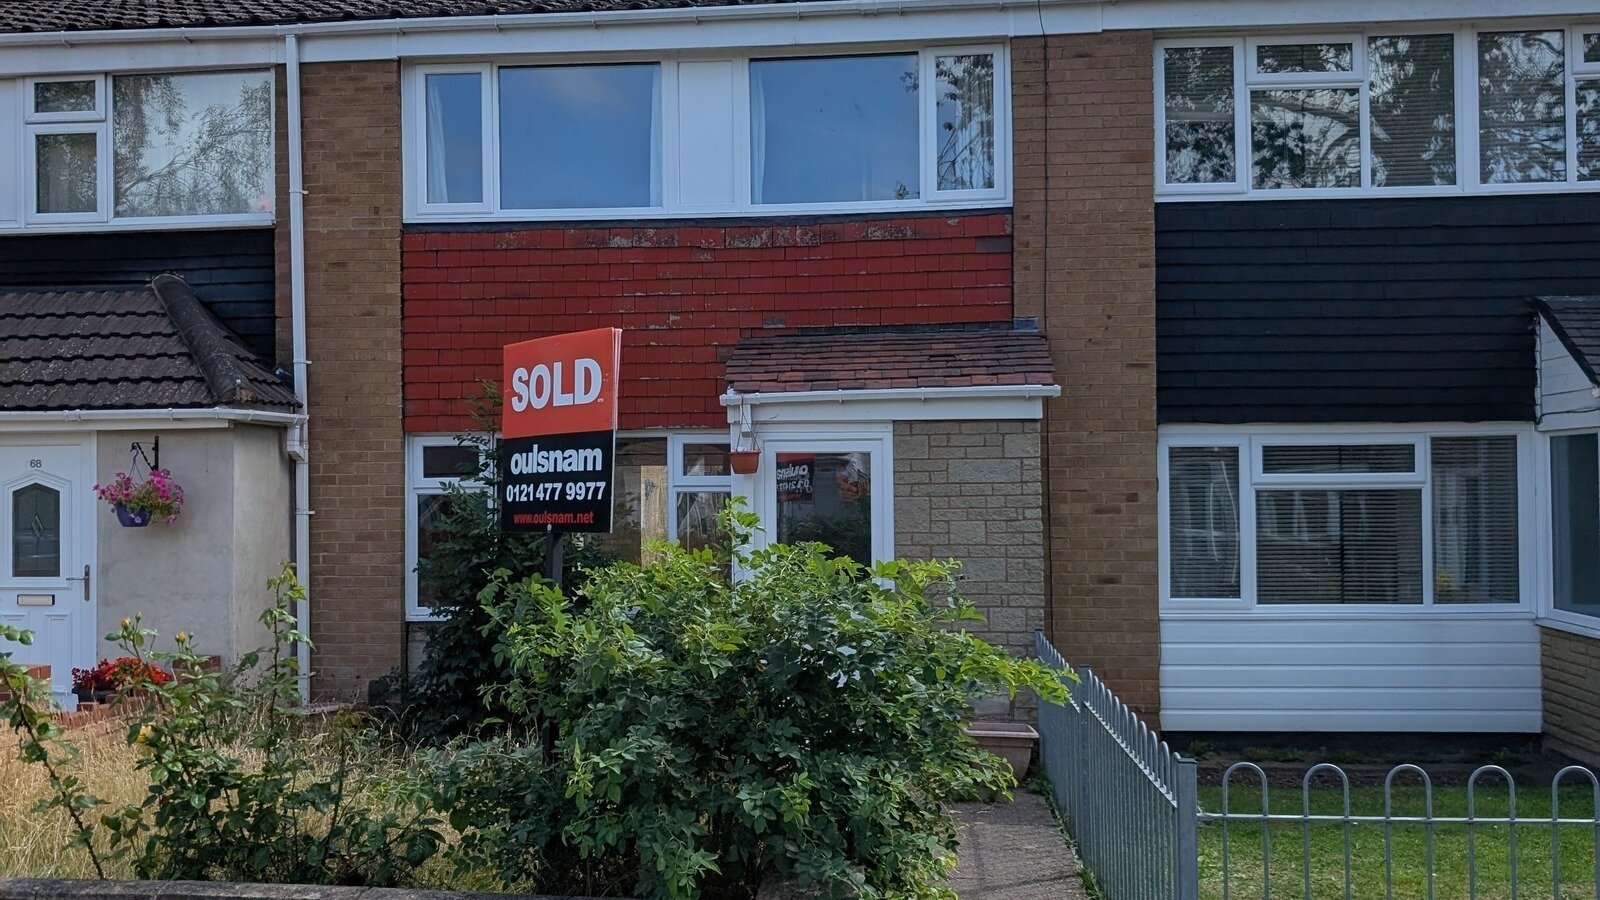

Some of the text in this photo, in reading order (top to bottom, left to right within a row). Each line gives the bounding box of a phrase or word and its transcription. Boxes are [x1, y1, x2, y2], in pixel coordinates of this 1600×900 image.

[511, 358, 602, 413] SOLD
[30, 459, 42, 468] 68
[511, 444, 602, 475] oulsnam
[506, 482, 606, 502] 0121 477 9977
[513, 510, 594, 524] www.oulsnam.net
